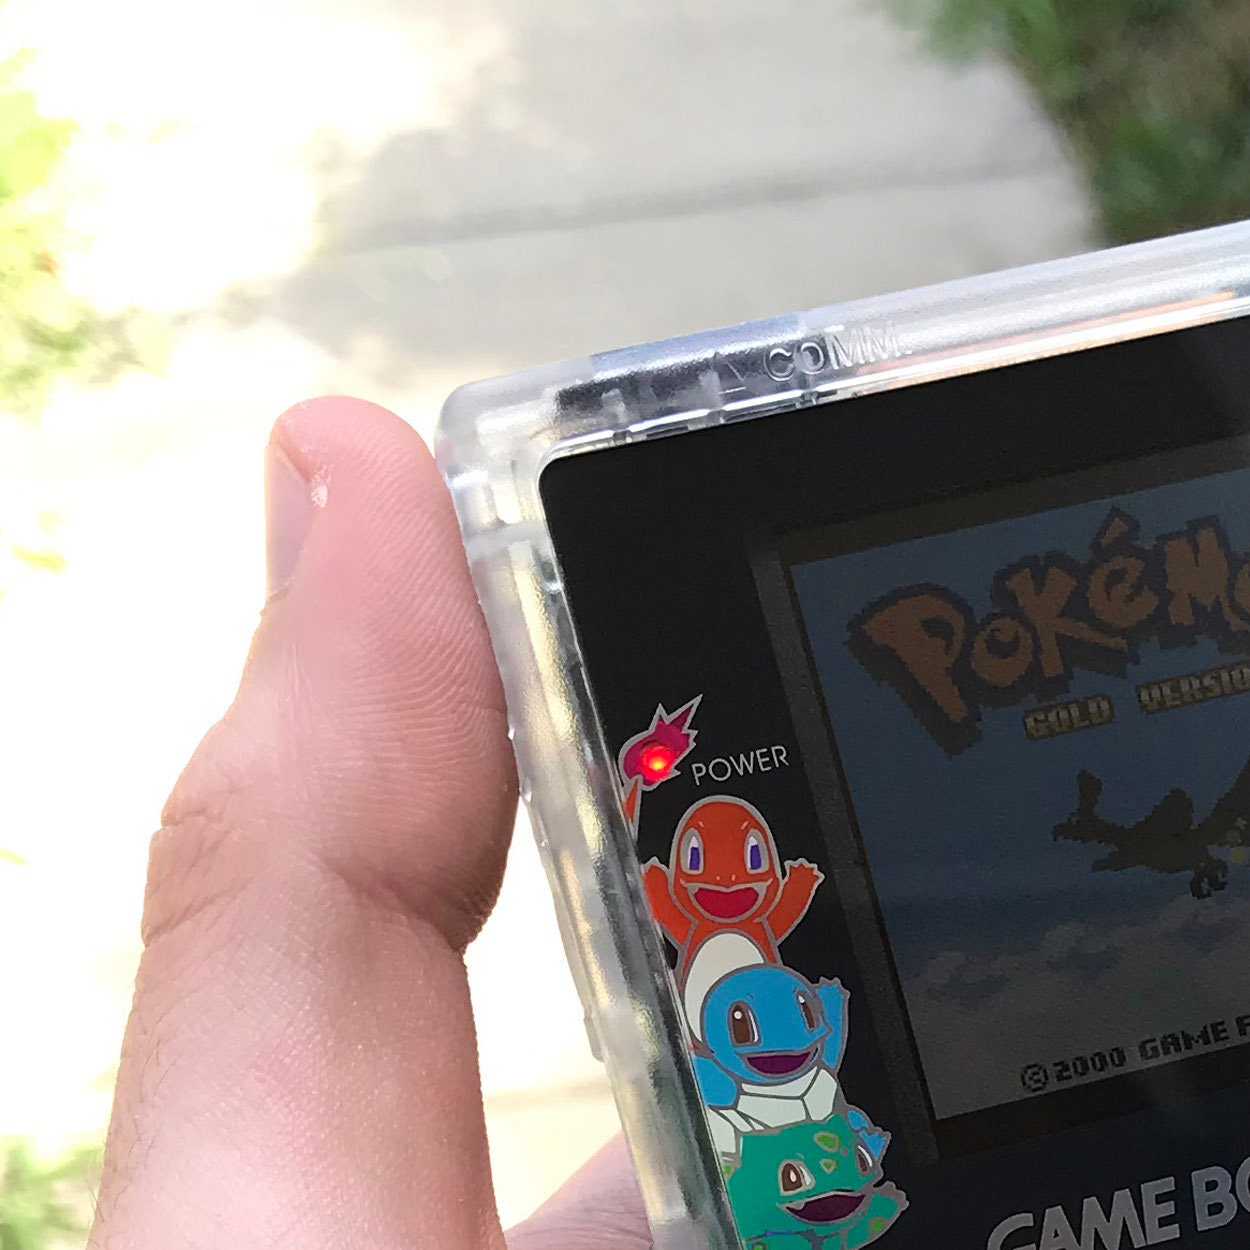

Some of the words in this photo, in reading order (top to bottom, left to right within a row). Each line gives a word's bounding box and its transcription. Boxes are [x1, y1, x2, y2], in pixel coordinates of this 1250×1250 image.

[1023, 695, 1115, 741] GOLD
[691, 745, 790, 786] POWER
[1138, 1020, 1231, 1062] GAME
